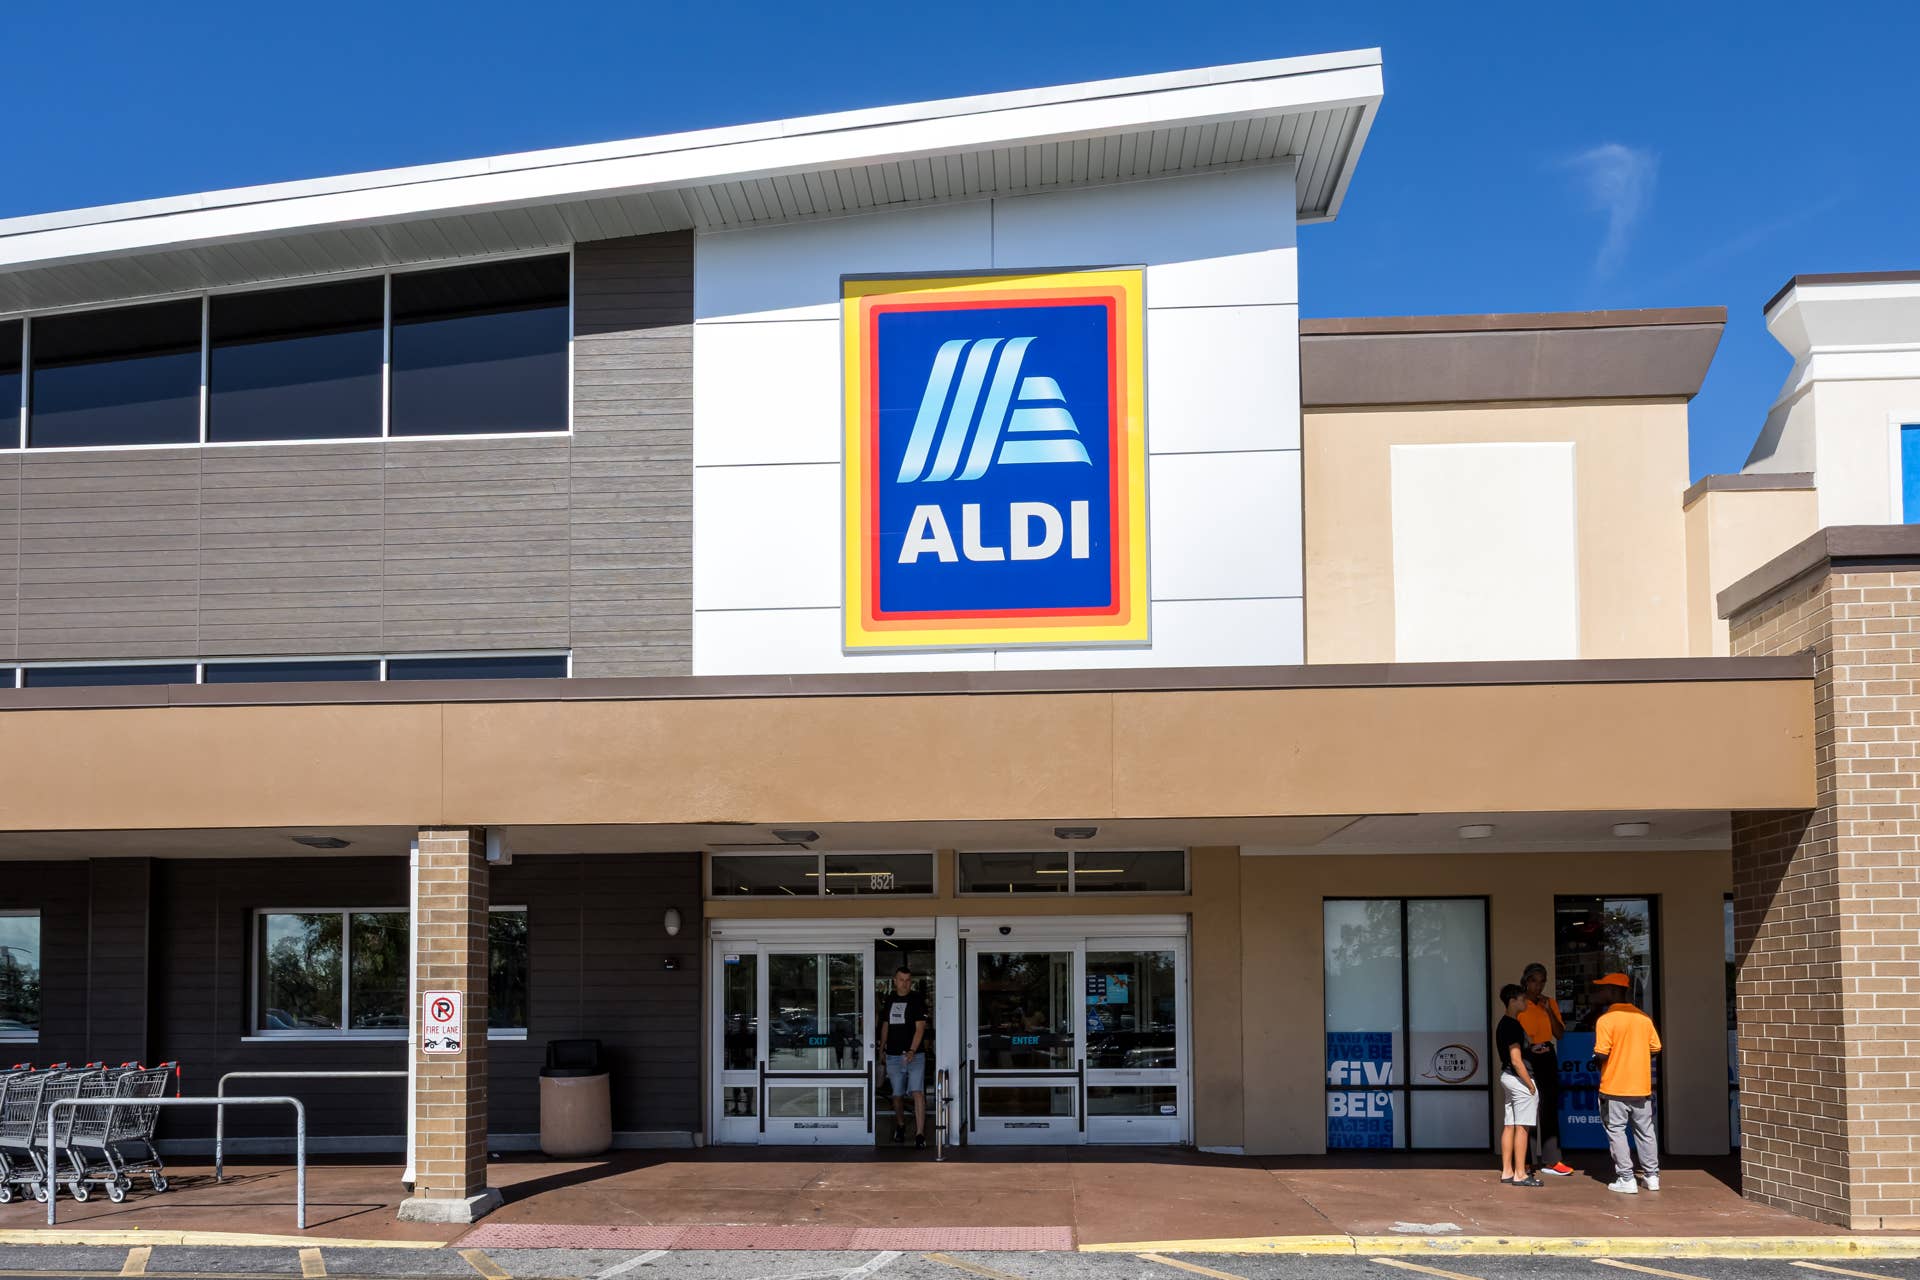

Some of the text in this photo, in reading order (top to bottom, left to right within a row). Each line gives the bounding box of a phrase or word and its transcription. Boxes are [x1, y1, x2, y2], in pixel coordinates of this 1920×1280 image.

[898, 500, 1090, 564] ALDI
[870, 873, 894, 890] 8521
[426, 1026, 459, 1034] FIRE LANE
[808, 1037, 828, 1046] EXIT
[1011, 1036, 1039, 1045] ENTER
[1327, 1060, 1393, 1085] fiv
[1567, 1114, 1602, 1124] five BE
